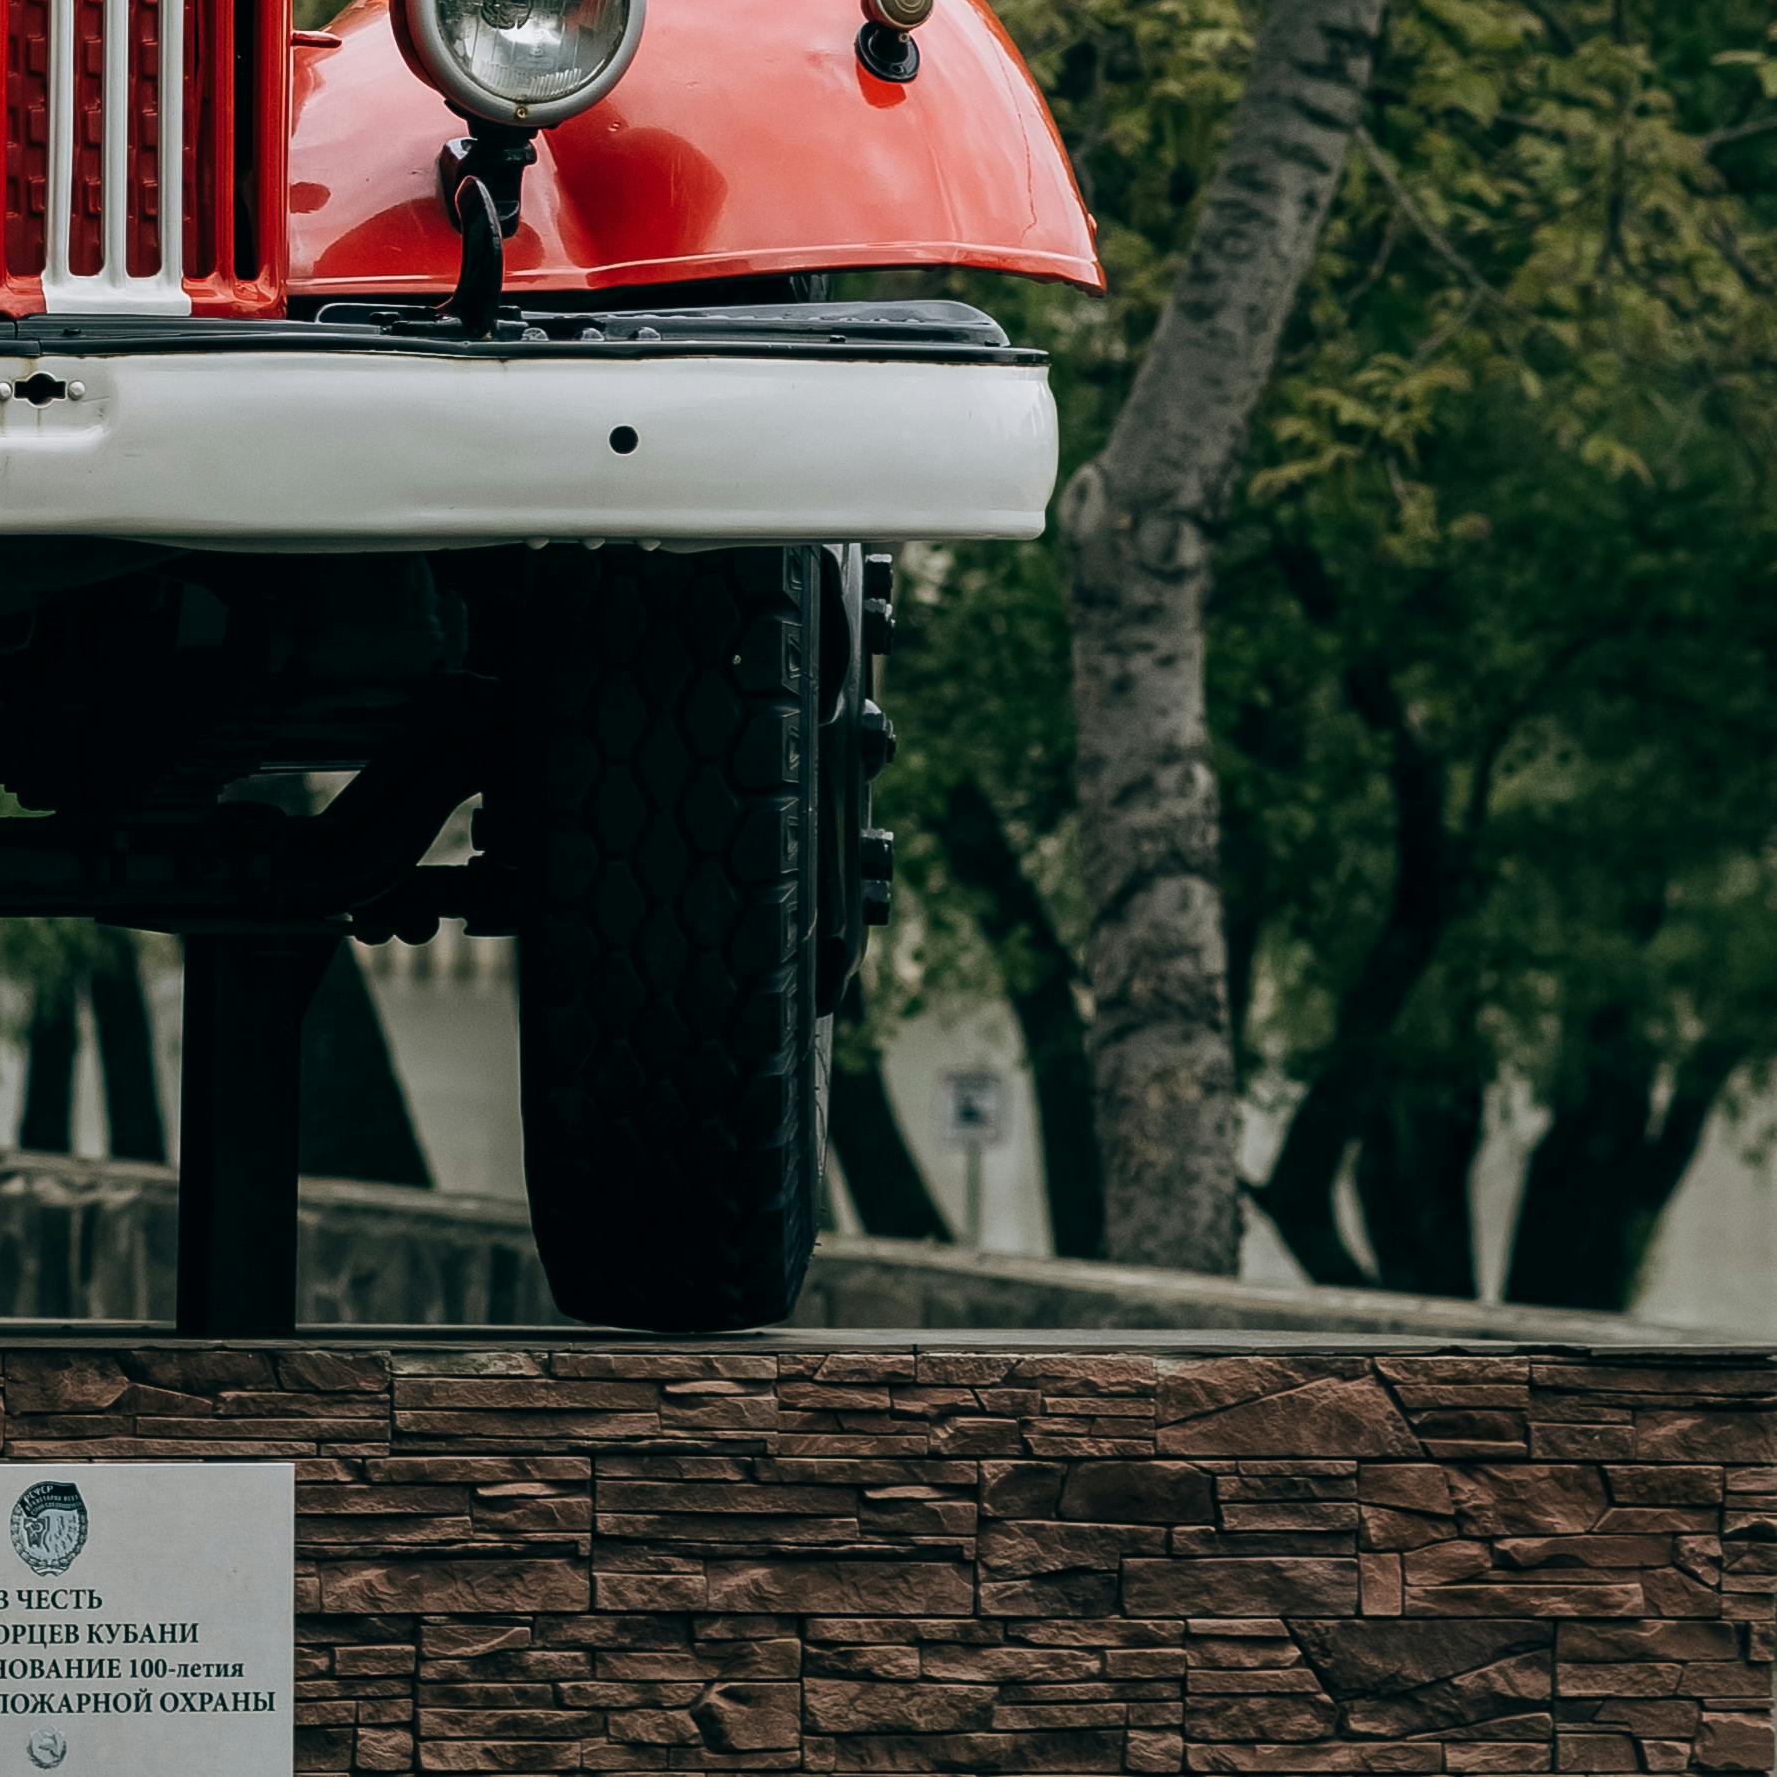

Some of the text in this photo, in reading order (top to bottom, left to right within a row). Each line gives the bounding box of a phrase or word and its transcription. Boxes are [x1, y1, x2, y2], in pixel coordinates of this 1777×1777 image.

[15, 1588, 103, 1610] ЧЕСТЬ
[86, 1622, 199, 1645] КУБАНИ
[129, 1658, 244, 1679] 100-летия
[159, 1690, 276, 1713] ОХРАНЫ
